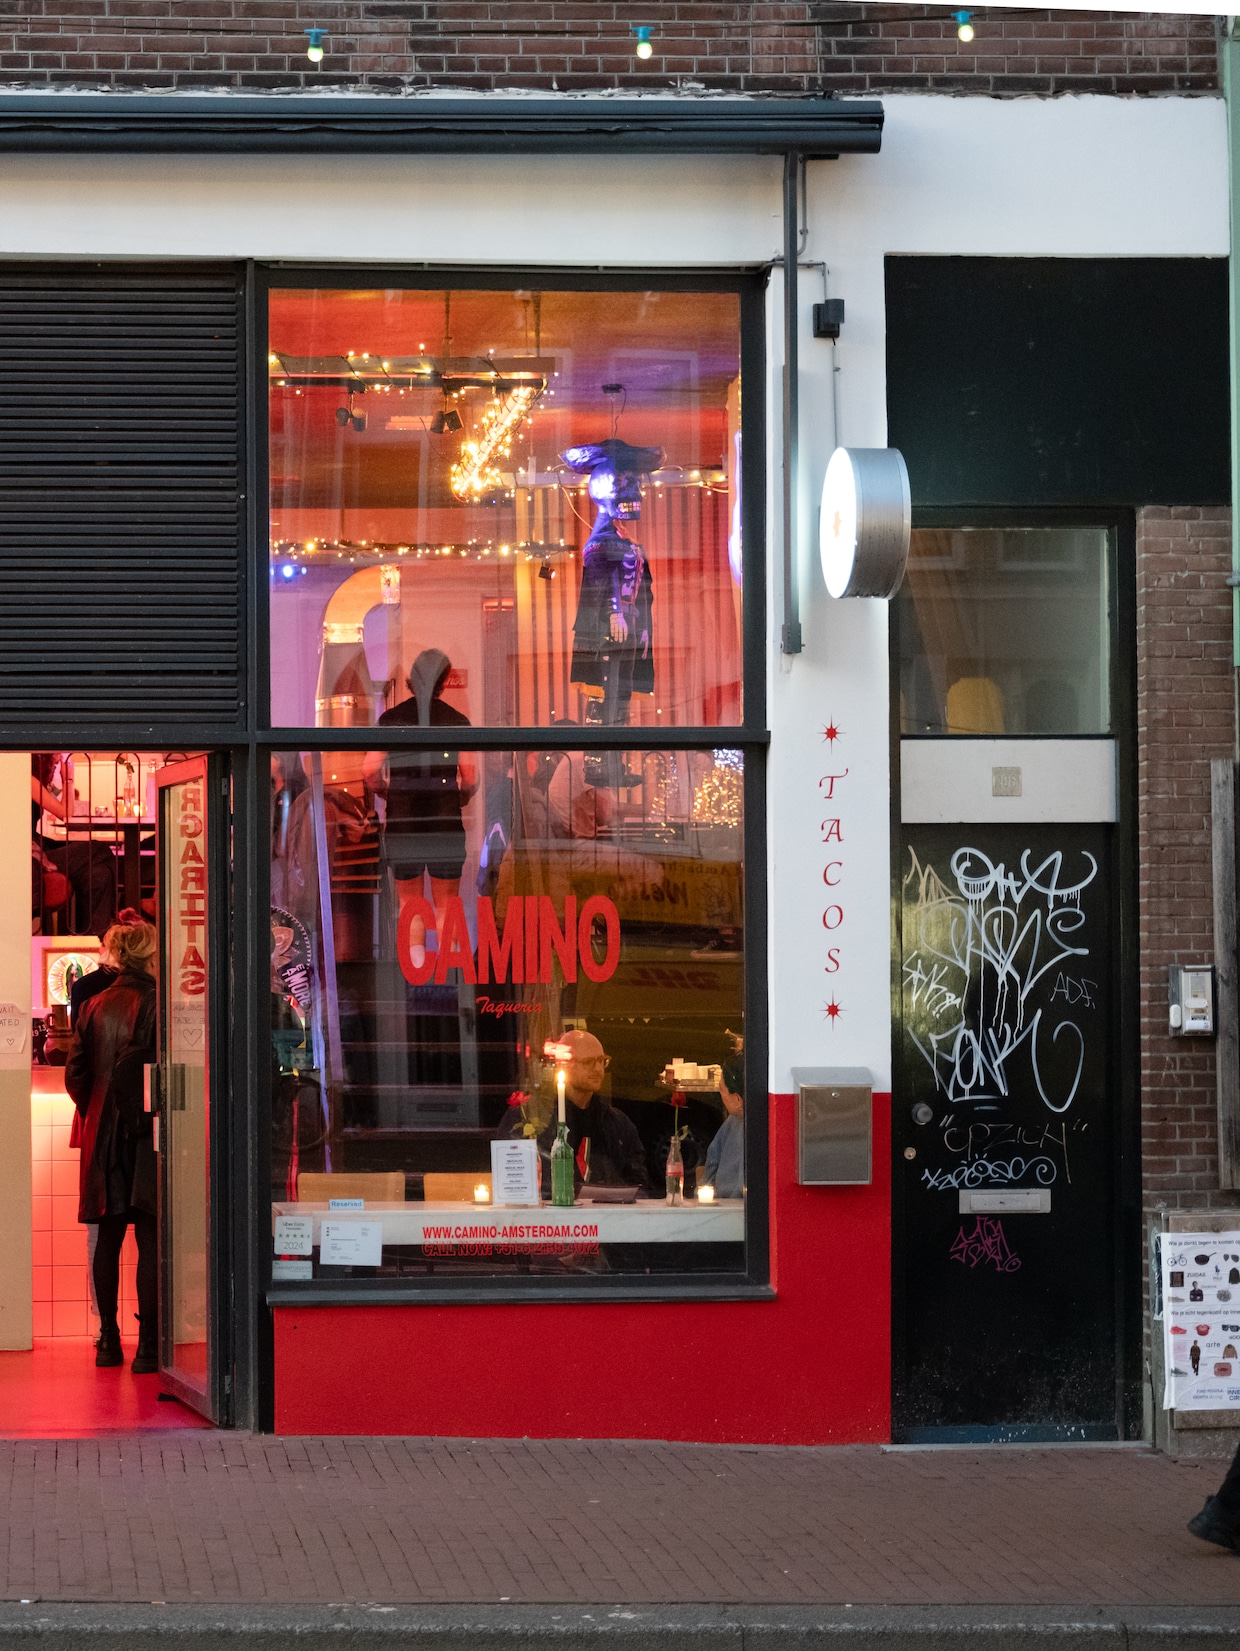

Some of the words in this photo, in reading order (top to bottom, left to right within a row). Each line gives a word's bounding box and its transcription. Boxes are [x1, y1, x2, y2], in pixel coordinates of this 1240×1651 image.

[819, 767, 848, 975] TACOS
[397, 895, 621, 986] CAMINO
[422, 1225, 599, 1239] WWW.CAMINO-AMSTERDAM.COM
[283, 1241, 304, 1250] 2024
[421, 1241, 456, 1256] CALL
